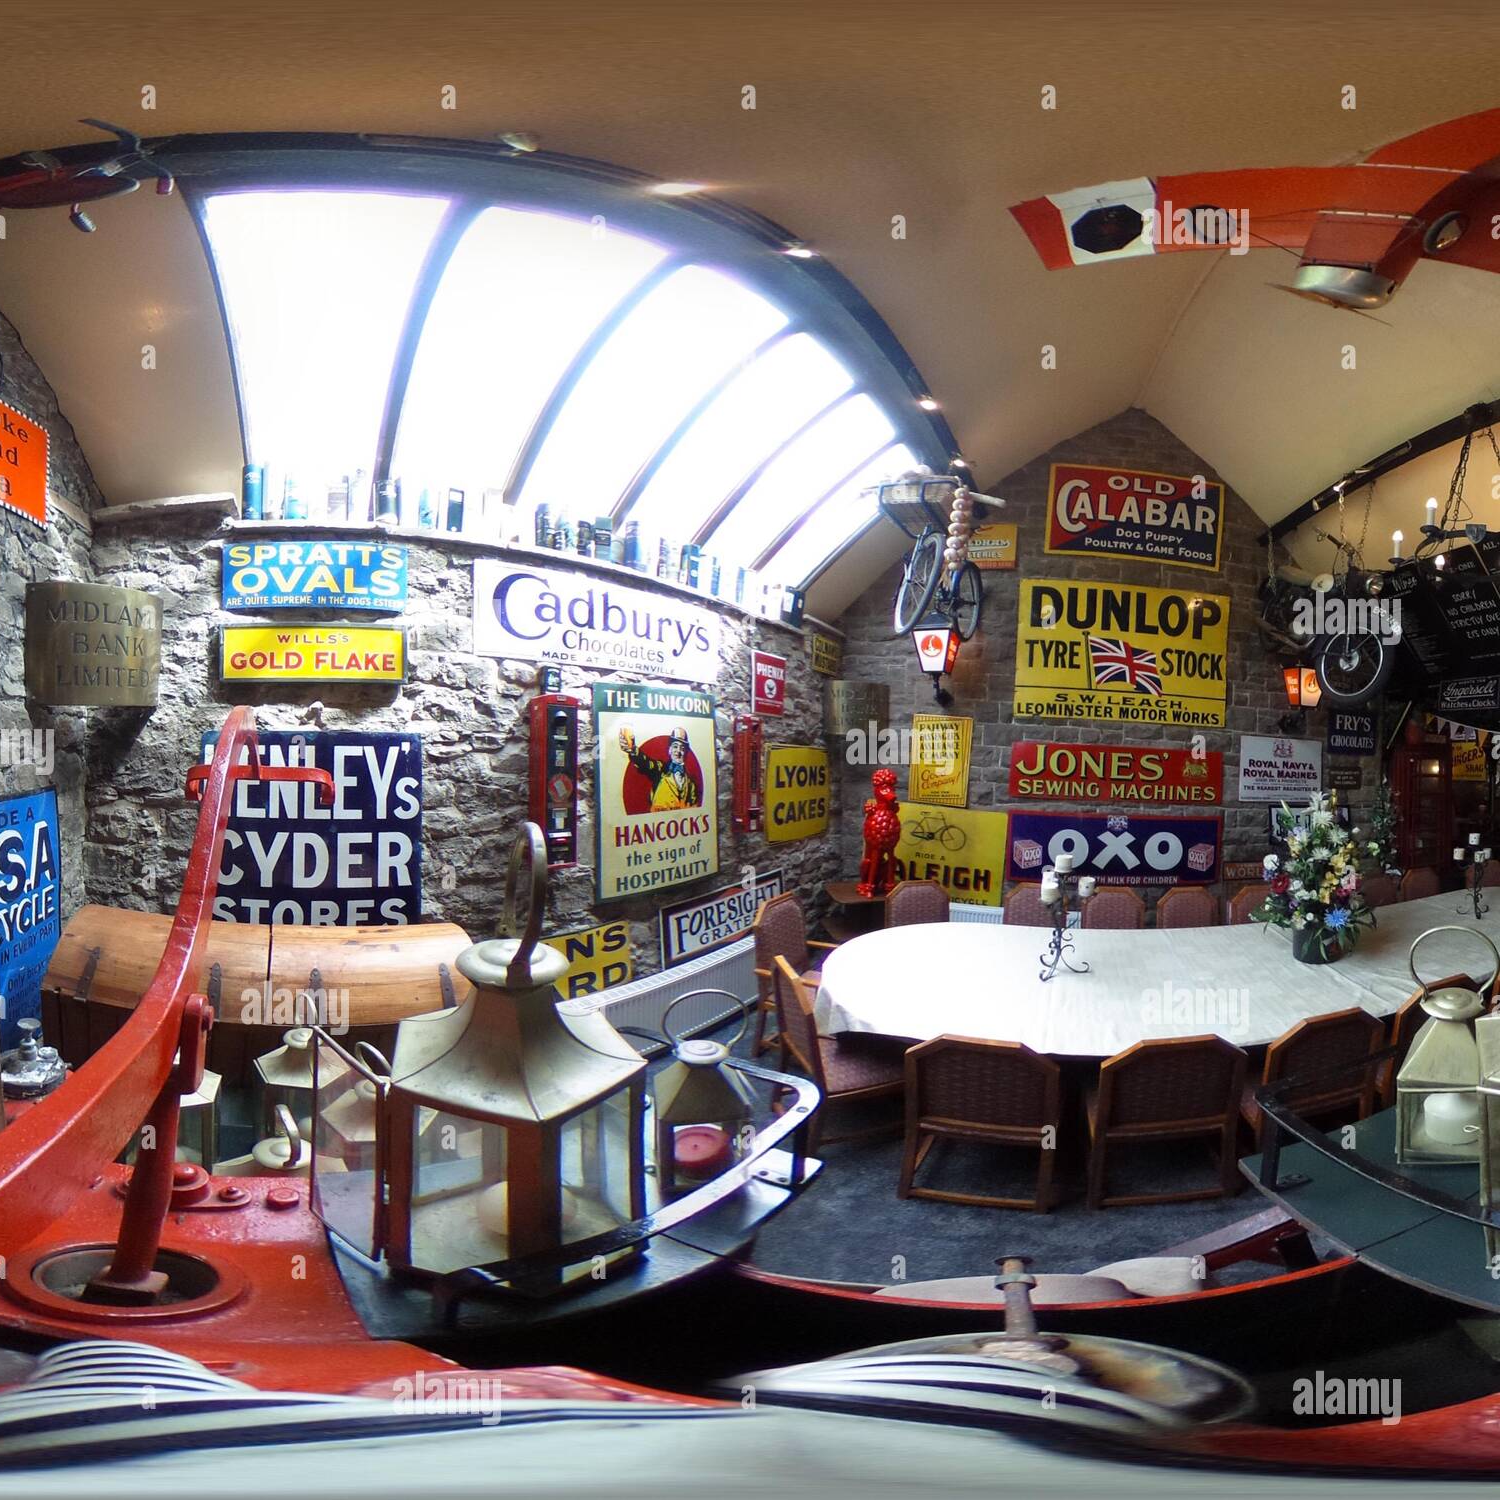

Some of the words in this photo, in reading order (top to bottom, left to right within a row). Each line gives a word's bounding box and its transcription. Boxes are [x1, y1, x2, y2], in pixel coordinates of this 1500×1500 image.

[1106, 474, 1176, 496] OLD
[1055, 478, 1217, 536] CALABAR
[1115, 527, 1141, 539] DOG
[1145, 530, 1184, 545] PUPPY
[228, 544, 404, 570] SPRATT'S
[1084, 537, 1133, 551] POULTRY
[1136, 541, 1144, 551] &
[1146, 542, 1175, 556] GAME
[1178, 546, 1213, 562] FOODS
[231, 566, 401, 597] OVALS
[226, 598, 243, 607] ARE
[244, 595, 269, 606] QUITE
[317, 596, 327, 604] IN
[328, 595, 345, 605] THE
[1451, 589, 1477, 603] SORRY
[1459, 600, 1497, 615] CHILDREN
[491, 572, 712, 658] Cadbury's
[1029, 585, 1223, 641] DUNLOP
[70, 632, 146, 657] BANK
[561, 627, 666, 664] Chocolates
[229, 651, 303, 671] GOLD
[314, 652, 396, 672] FLAKE
[541, 650, 578, 663] MADE
[586, 655, 601, 665] AT
[608, 659, 676, 676] BOURNVILLE
[755, 662, 786, 681] PHENIX
[1025, 639, 1082, 671] TYRE
[1159, 648, 1224, 681] STOCK
[56, 664, 150, 688] LIMITED
[1442, 679, 1498, 698] Ingersoll
[605, 688, 640, 709] THE
[646, 692, 711, 715] UNICORN
[1016, 701, 1116, 719] LEOMINSTER
[1118, 706, 1169, 723] MOTOR
[1171, 710, 1220, 726] WORKS
[1335, 713, 1372, 733] FRY'S
[1330, 733, 1375, 750] CHOCOLATES
[1015, 743, 1171, 782] JONES'
[1243, 768, 1274, 778] ROYAL
[1277, 770, 1318, 780] MARINES
[1248, 759, 1280, 769] ROYAL
[1282, 760, 1308, 770] NAVY
[774, 764, 827, 788] LYONS
[1017, 778, 1101, 798] SEWING
[1110, 783, 1217, 802] MACHINES
[25, 806, 35, 822] A
[772, 797, 827, 826] CAKES
[614, 813, 710, 848] HANCOCK'S
[217, 831, 413, 889] CYDER
[626, 847, 653, 867] the
[657, 843, 686, 865] sign
[689, 840, 702, 856] of
[915, 852, 935, 861] RIDE
[1023, 847, 1042, 862] OXO
[1047, 828, 1184, 872] OXO
[1189, 850, 1207, 862] OXO
[615, 857, 711, 893] HOSPITALITY
[1107, 876, 1125, 885] MILK
[1126, 876, 1141, 885] FOR
[1142, 876, 1179, 886] CHILDREN
[674, 882, 778, 954] FORESIGHT
[699, 914, 756, 946] GRATE
[0, 948, 11, 966] IN
